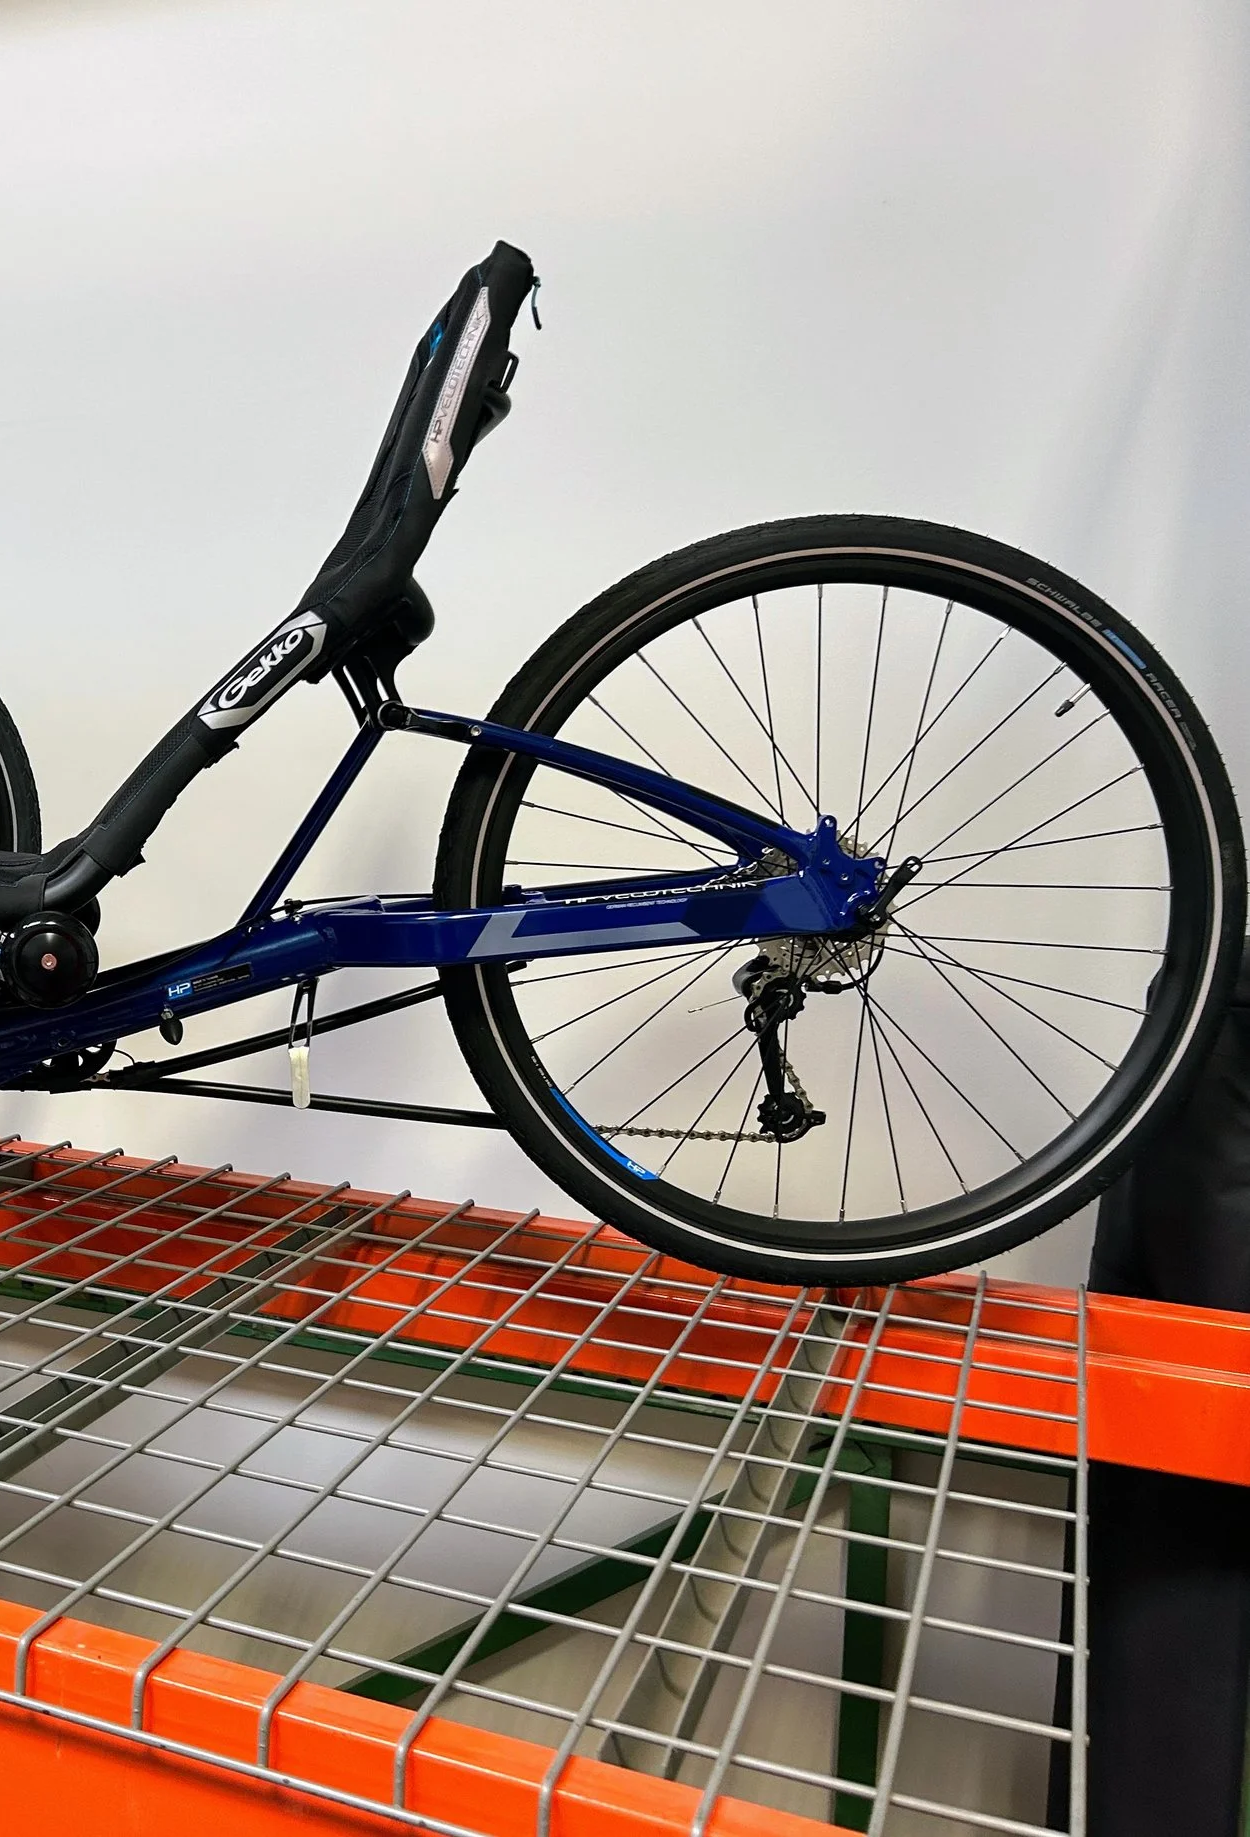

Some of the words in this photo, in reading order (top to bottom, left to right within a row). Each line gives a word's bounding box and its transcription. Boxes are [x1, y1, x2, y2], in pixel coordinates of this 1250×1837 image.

[1025, 577, 1103, 628] SCHWALBE
[217, 628, 304, 709] Gekko
[168, 982, 191, 997] HP
